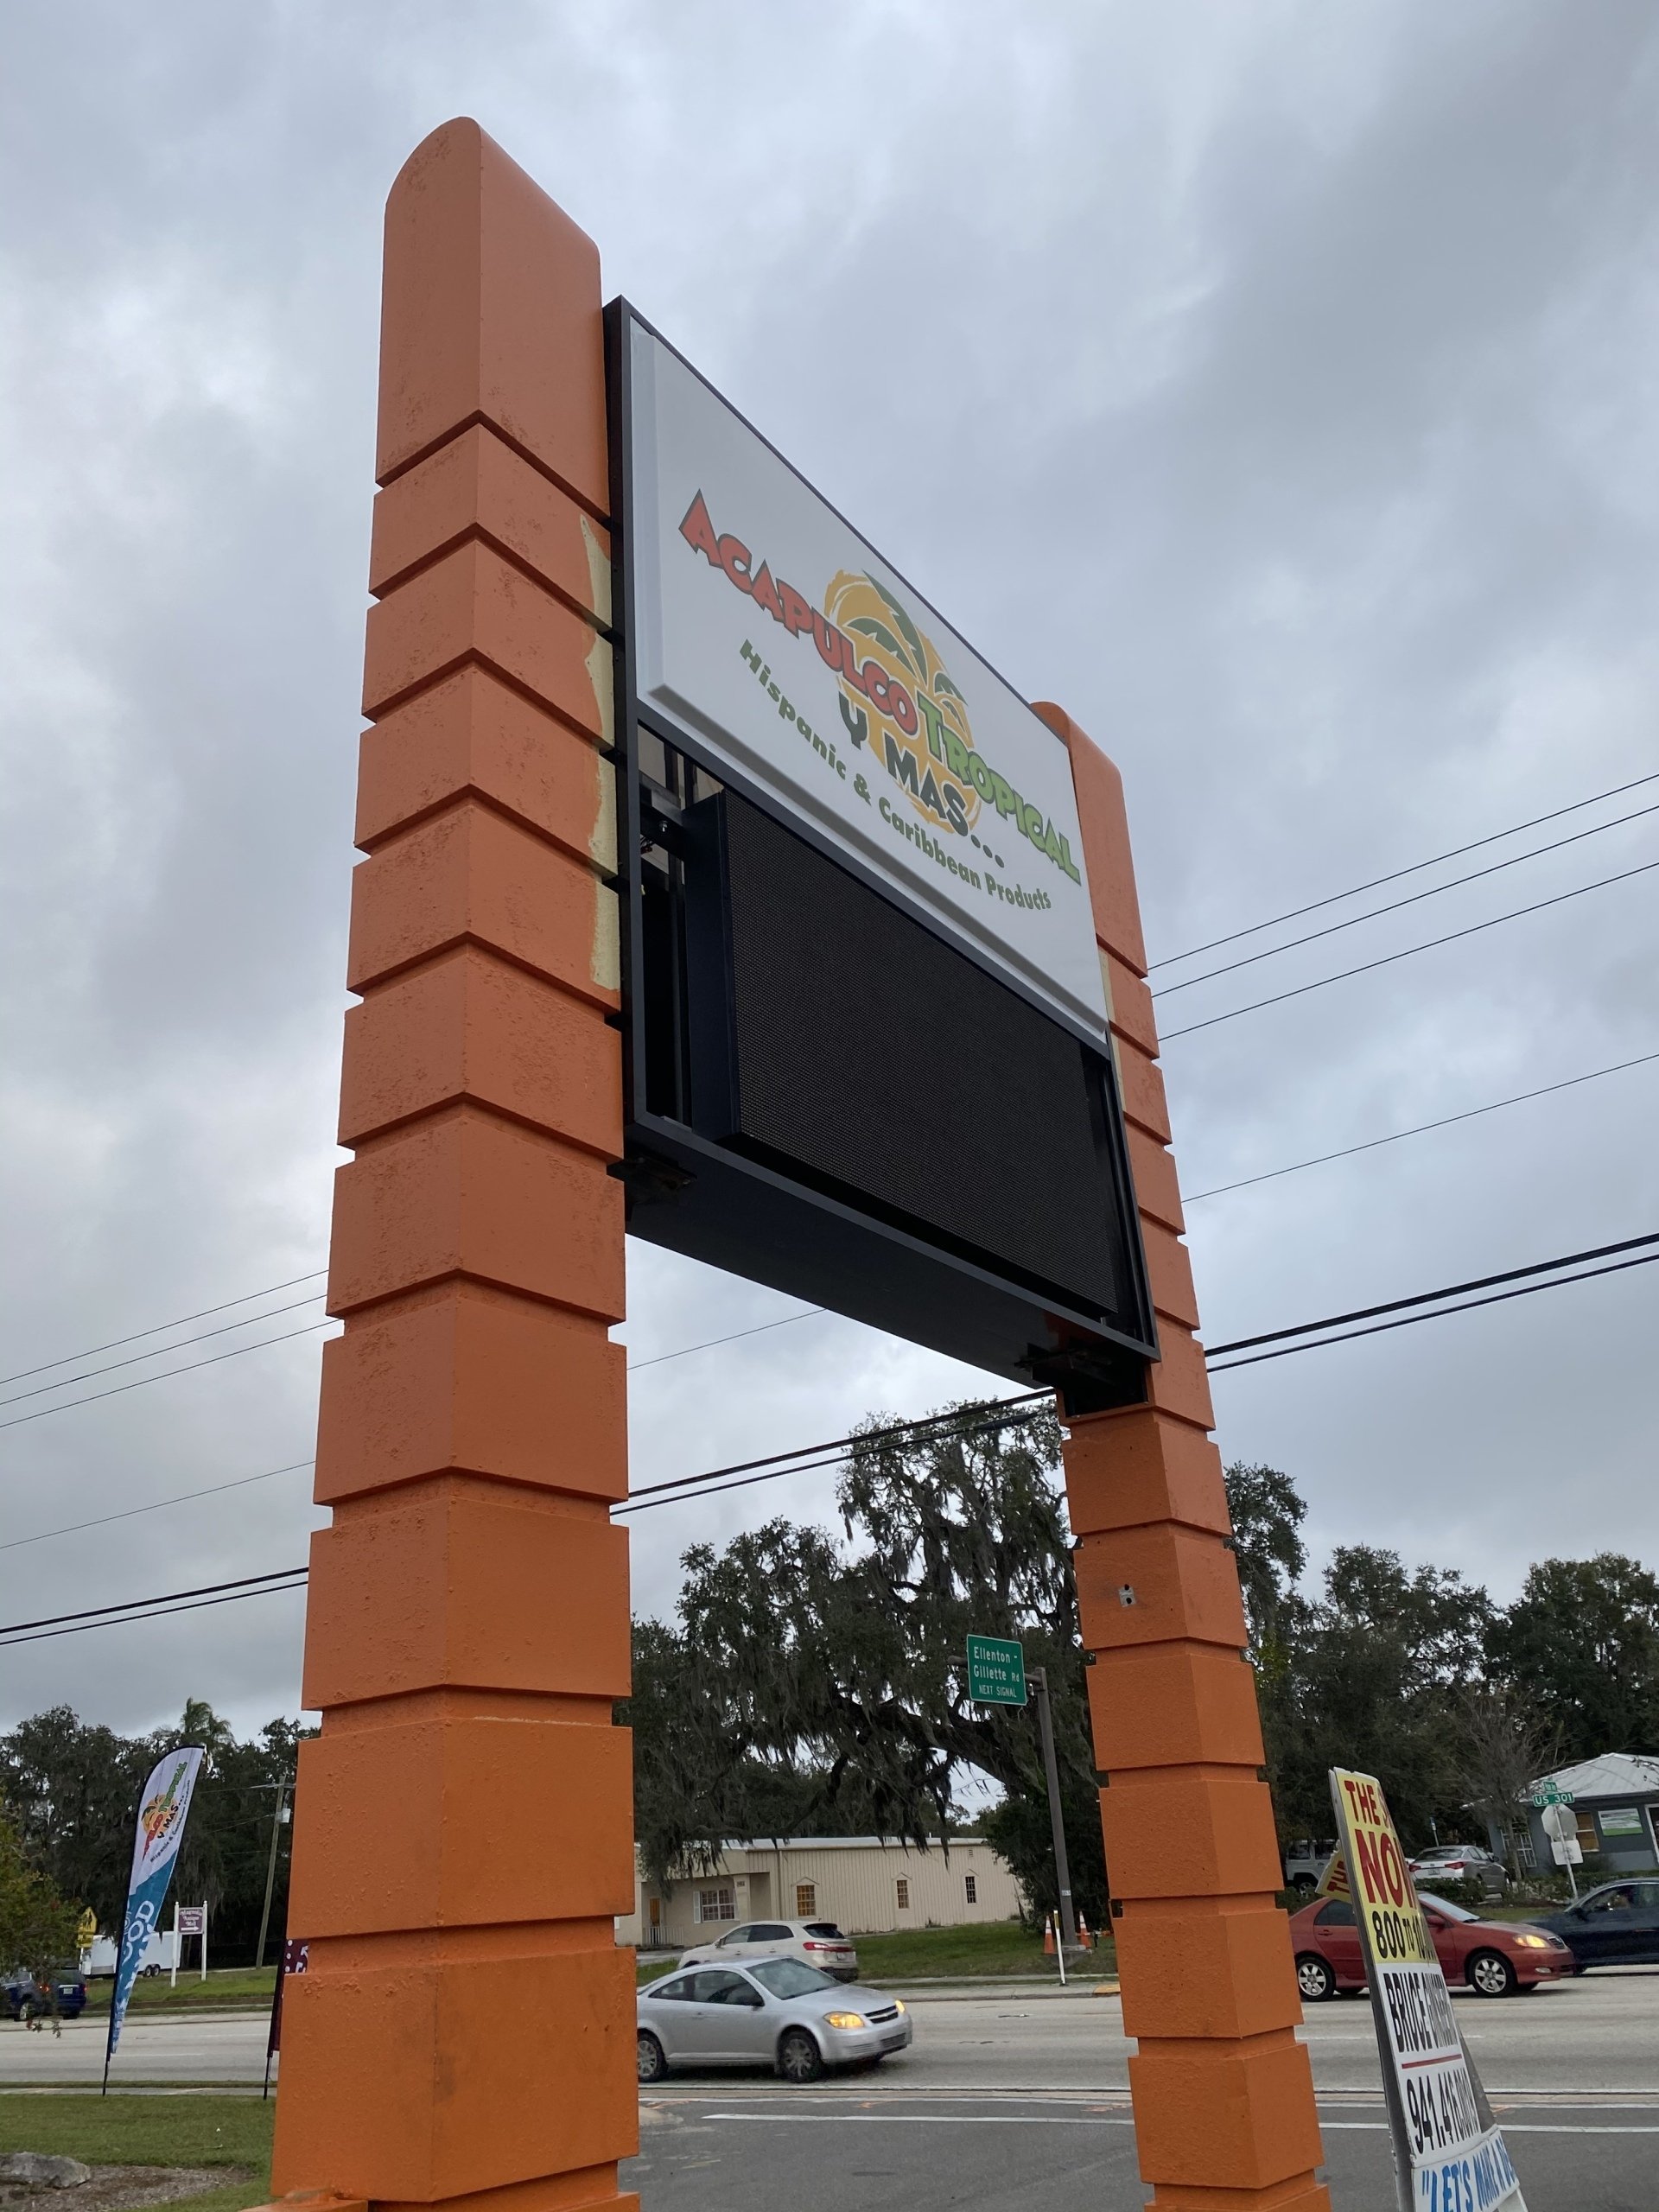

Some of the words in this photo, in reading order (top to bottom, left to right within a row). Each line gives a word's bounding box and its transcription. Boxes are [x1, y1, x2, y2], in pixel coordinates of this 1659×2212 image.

[679, 488, 918, 735] ACAPULCO
[916, 687, 1081, 887] TROPICAL
[837, 690, 868, 750] Y
[739, 639, 848, 781] Hispanic
[853, 776, 872, 807] &
[879, 797, 982, 889] Caribbean
[984, 873, 1052, 911] Products
[973, 1664, 1007, 1681] Gillette
[1011, 1672, 1020, 1682] Rd
[979, 1684, 993, 1695] NEXT
[996, 1686, 1017, 1698] SIGNAL
[1344, 1780, 1381, 1827] THE
[1535, 1796, 1550, 1806] US
[1554, 1793, 1573, 1803] 301
[1372, 1910, 1406, 1959] 800
[1382, 1972, 1433, 2053] BRUCE
